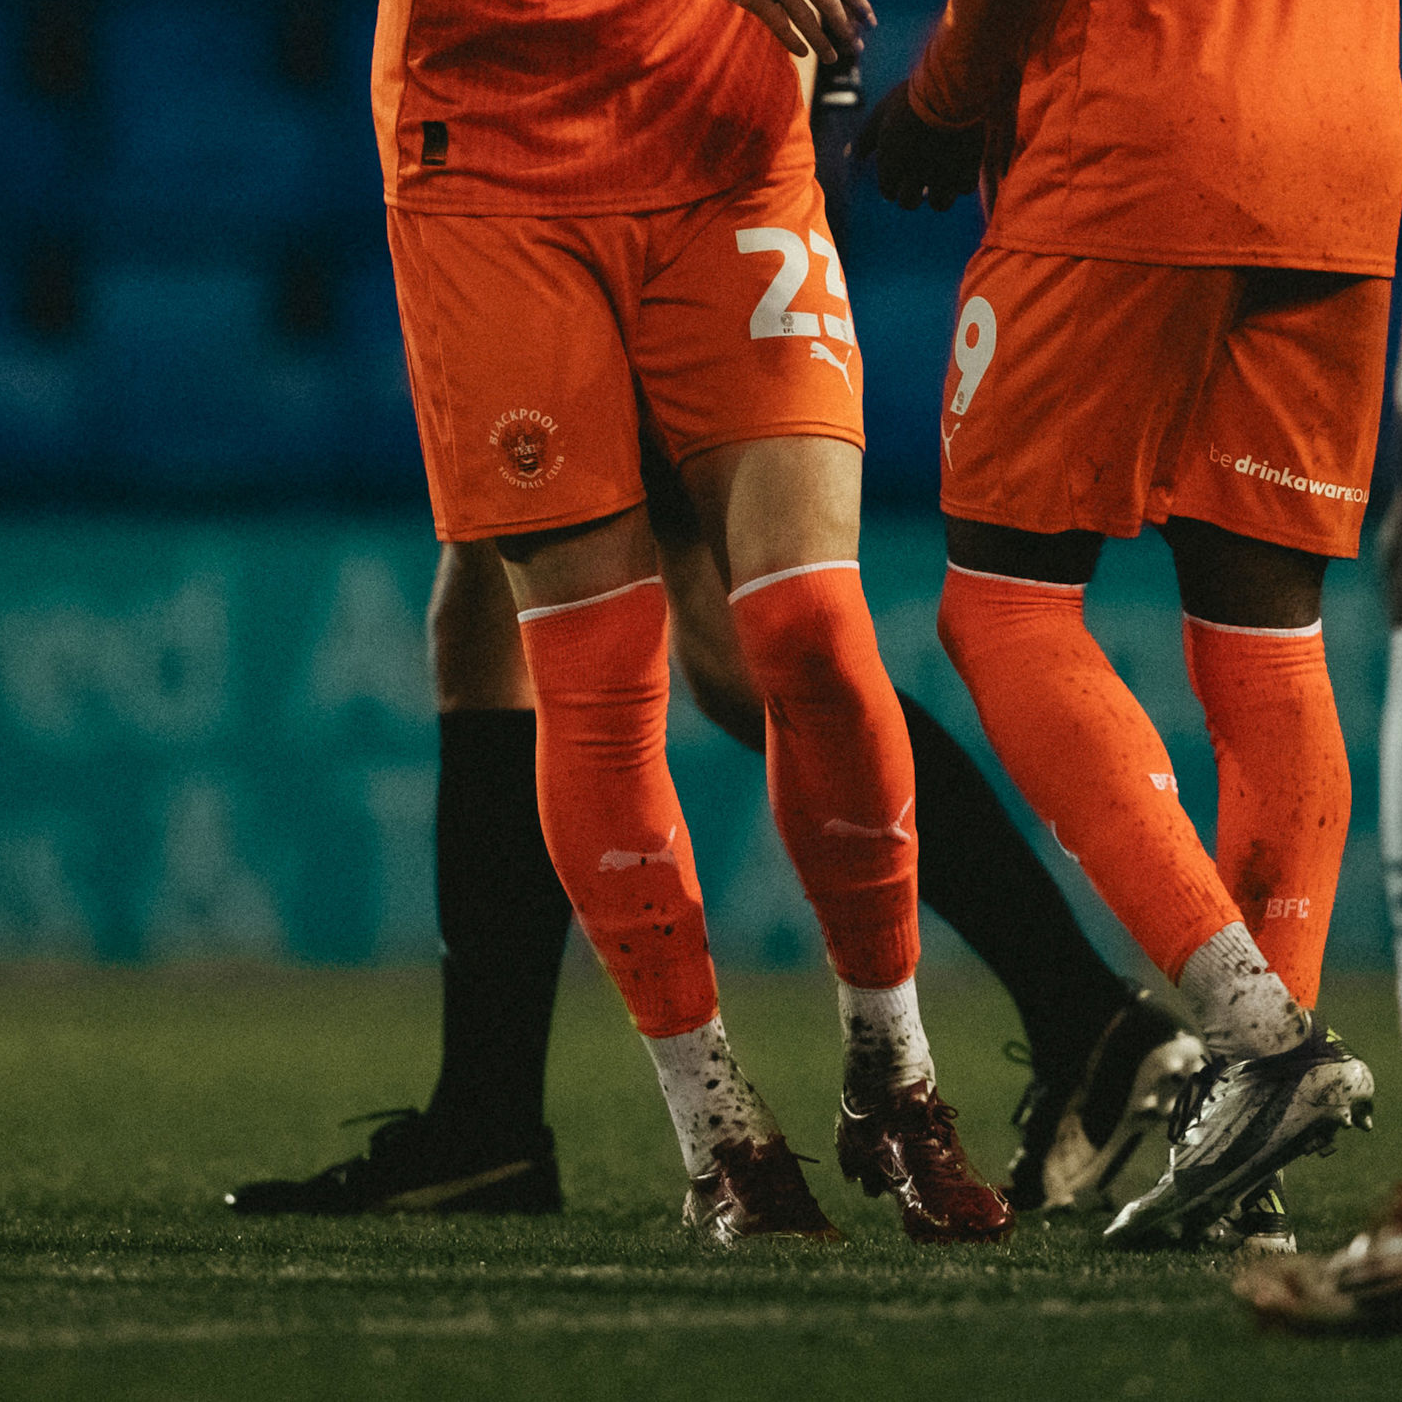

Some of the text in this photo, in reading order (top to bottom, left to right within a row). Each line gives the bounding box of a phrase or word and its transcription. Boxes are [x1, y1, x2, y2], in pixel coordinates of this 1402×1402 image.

[735, 226, 855, 347] 23
[950, 295, 997, 416] 9
[489, 408, 559, 446] BLACKPOOL
[546, 455, 565, 480] CLUB
[1208, 442, 1233, 468] be
[1265, 896, 1310, 919] BFC
